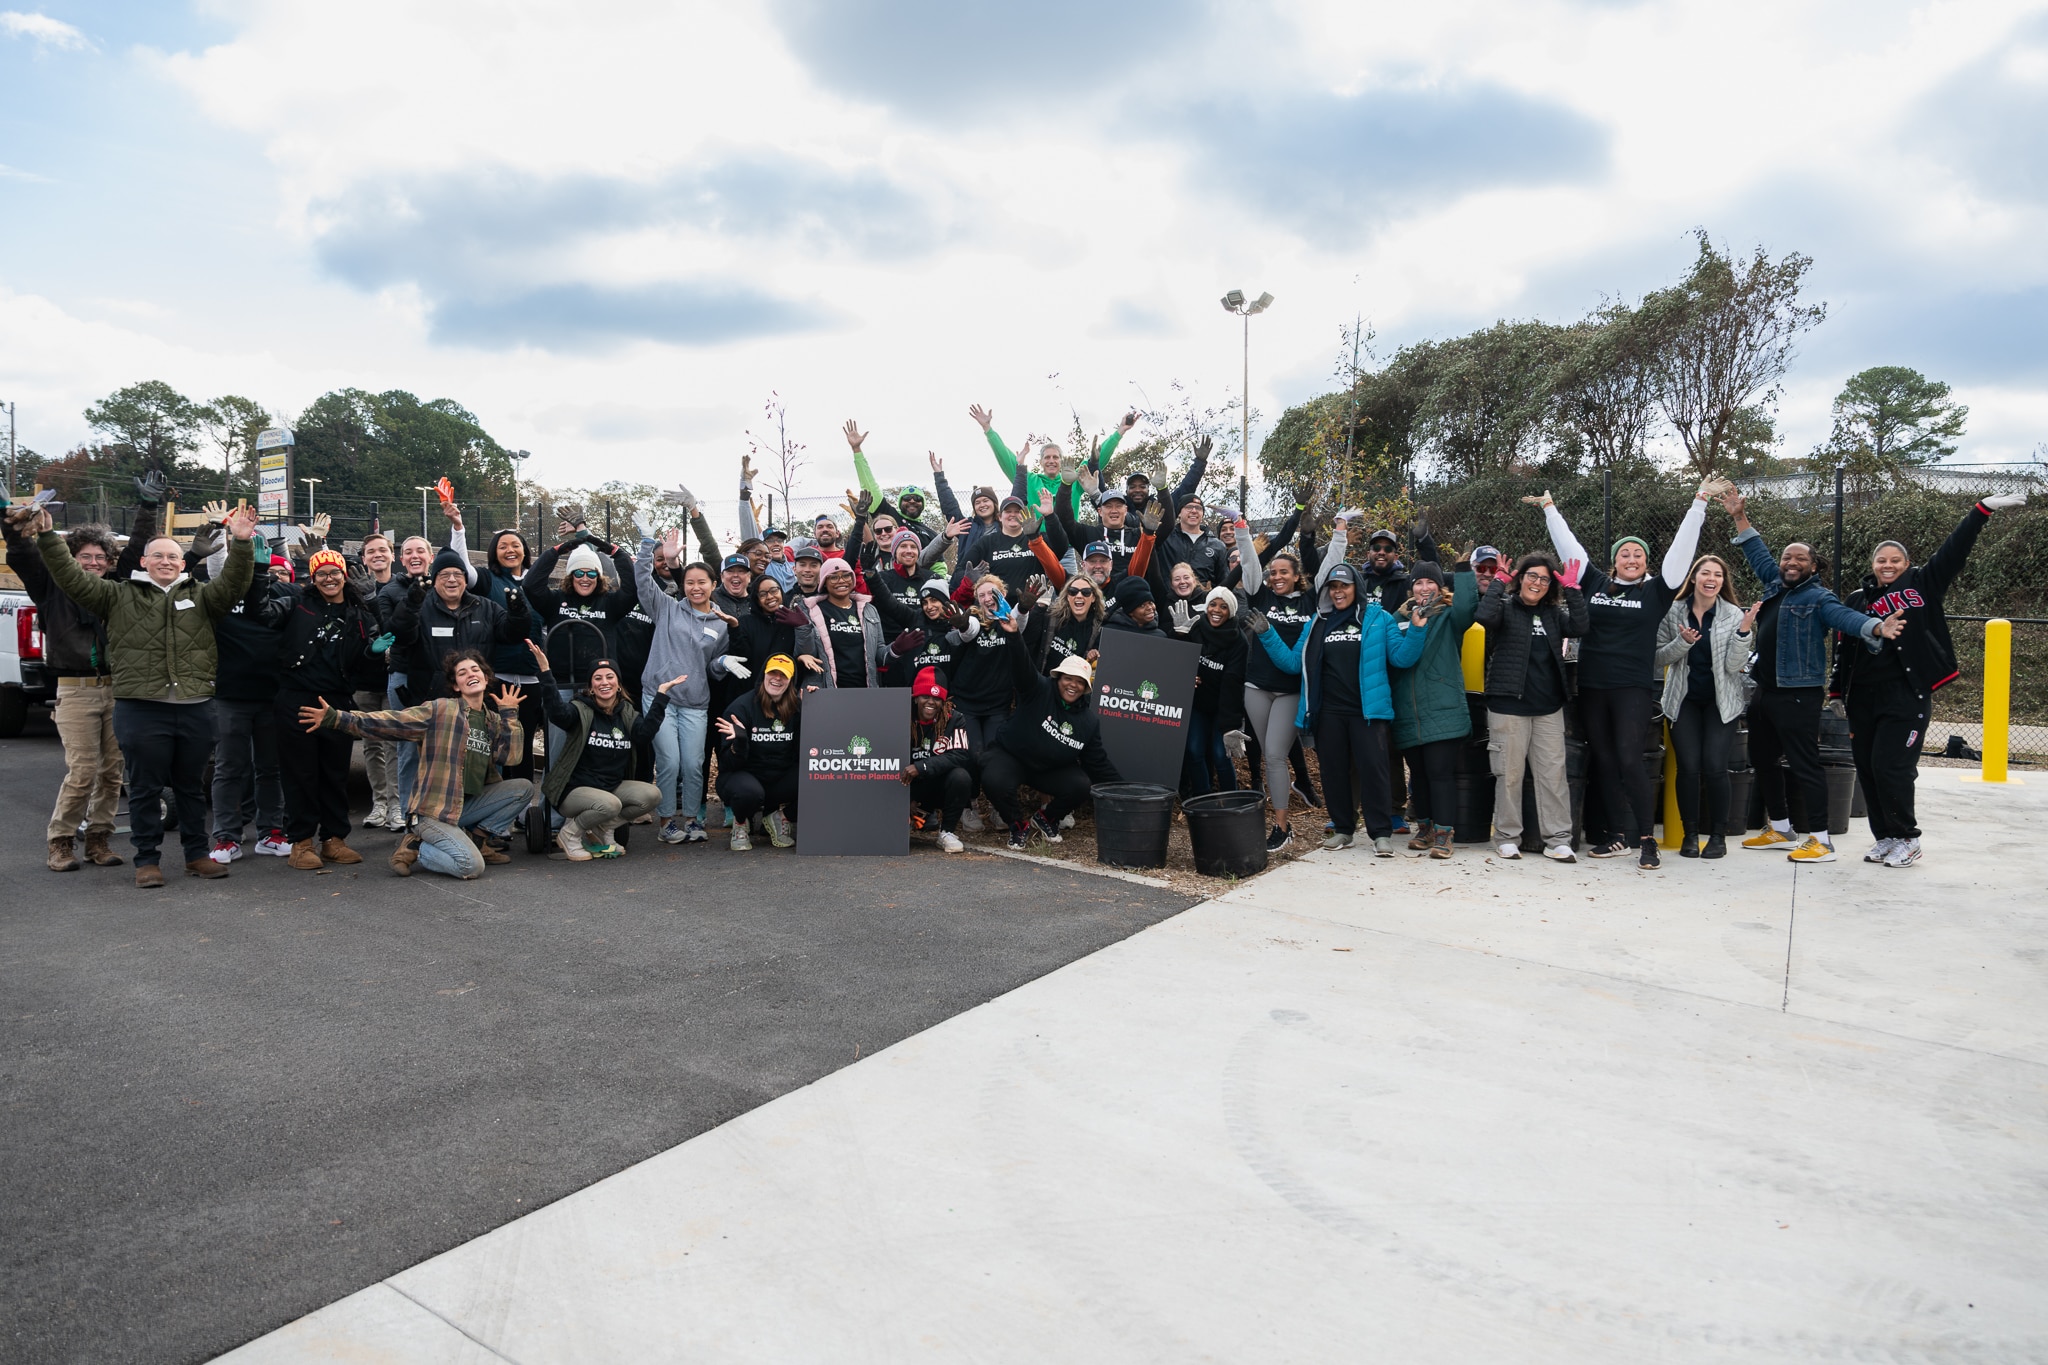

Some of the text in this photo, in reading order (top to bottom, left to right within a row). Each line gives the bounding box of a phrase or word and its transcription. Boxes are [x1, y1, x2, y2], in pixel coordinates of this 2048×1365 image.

[265, 476, 285, 485] Goodwill
[992, 552, 1014, 560] ROCK
[1621, 600, 1641, 608] RIM
[559, 607, 581, 620] ROCK
[1208, 660, 1224, 671] RIM
[1099, 694, 1183, 719] ROCK THE RIM
[1103, 708, 1122, 718] Dunk
[1136, 714, 1150, 723] Tree
[1152, 716, 1181, 727] Planted
[752, 734, 775, 742] ROCK
[947, 728, 968, 750] HAW
[1042, 720, 1061, 740] ROCK
[1068, 738, 1085, 750] RIM
[466, 738, 490, 752] LANTA
[588, 736, 614, 748] ROCK
[808, 758, 900, 771] ROCK THE RIM
